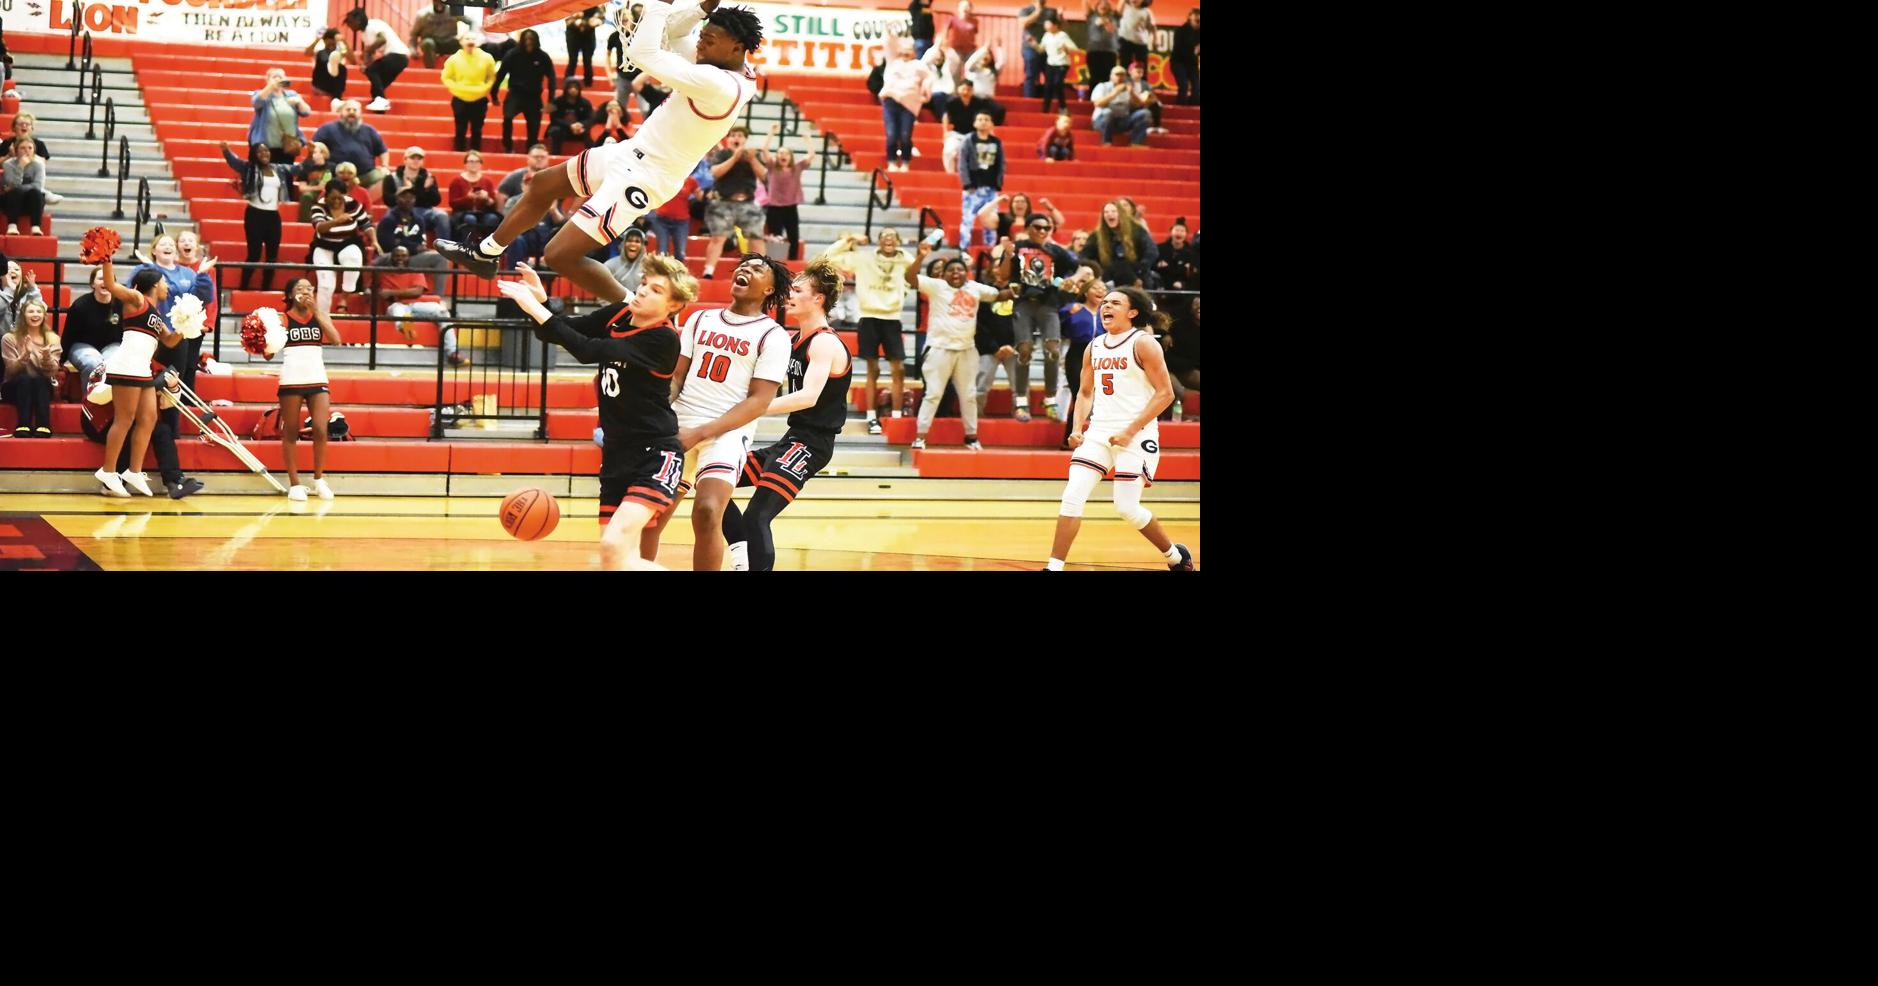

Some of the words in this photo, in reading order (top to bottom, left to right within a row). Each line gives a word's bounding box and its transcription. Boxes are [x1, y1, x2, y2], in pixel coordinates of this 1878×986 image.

[774, 14, 845, 37] STILL
[624, 185, 649, 210] G
[697, 330, 751, 357] LIONS
[696, 351, 732, 383] 10
[1093, 357, 1128, 370] LIONS
[1101, 373, 1115, 396] 5
[1140, 439, 1159, 454] G
